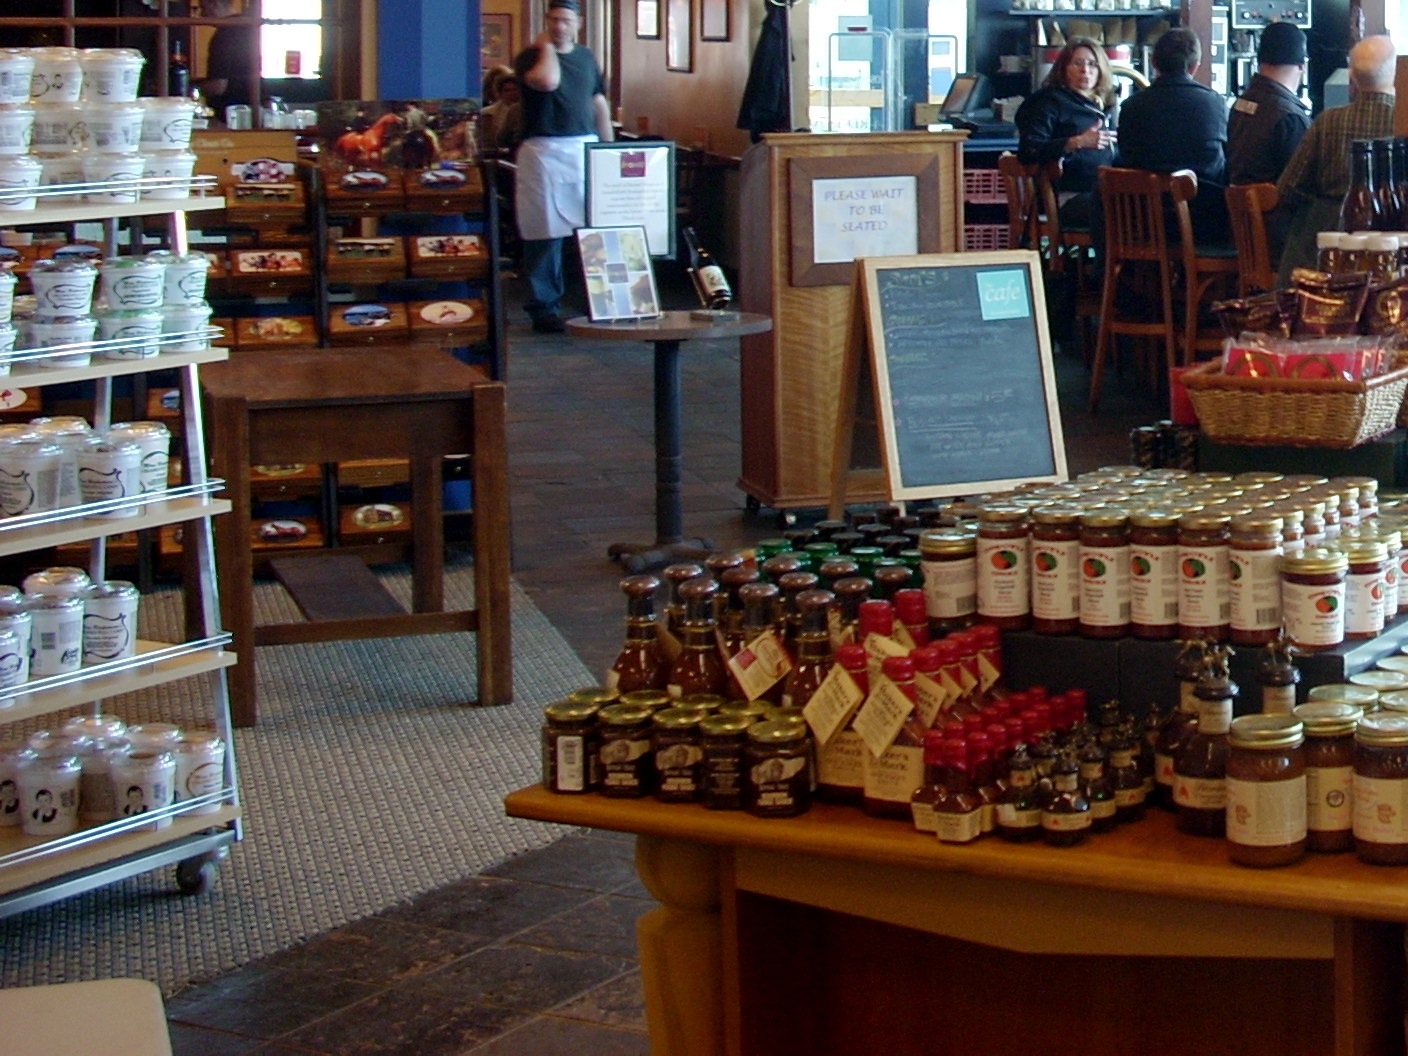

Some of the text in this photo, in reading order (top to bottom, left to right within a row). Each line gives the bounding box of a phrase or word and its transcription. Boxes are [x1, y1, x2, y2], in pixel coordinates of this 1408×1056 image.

[823, 188, 904, 202] PLEASE WAIT
[848, 204, 884, 216] TO BE
[840, 220, 888, 233] SEATED
